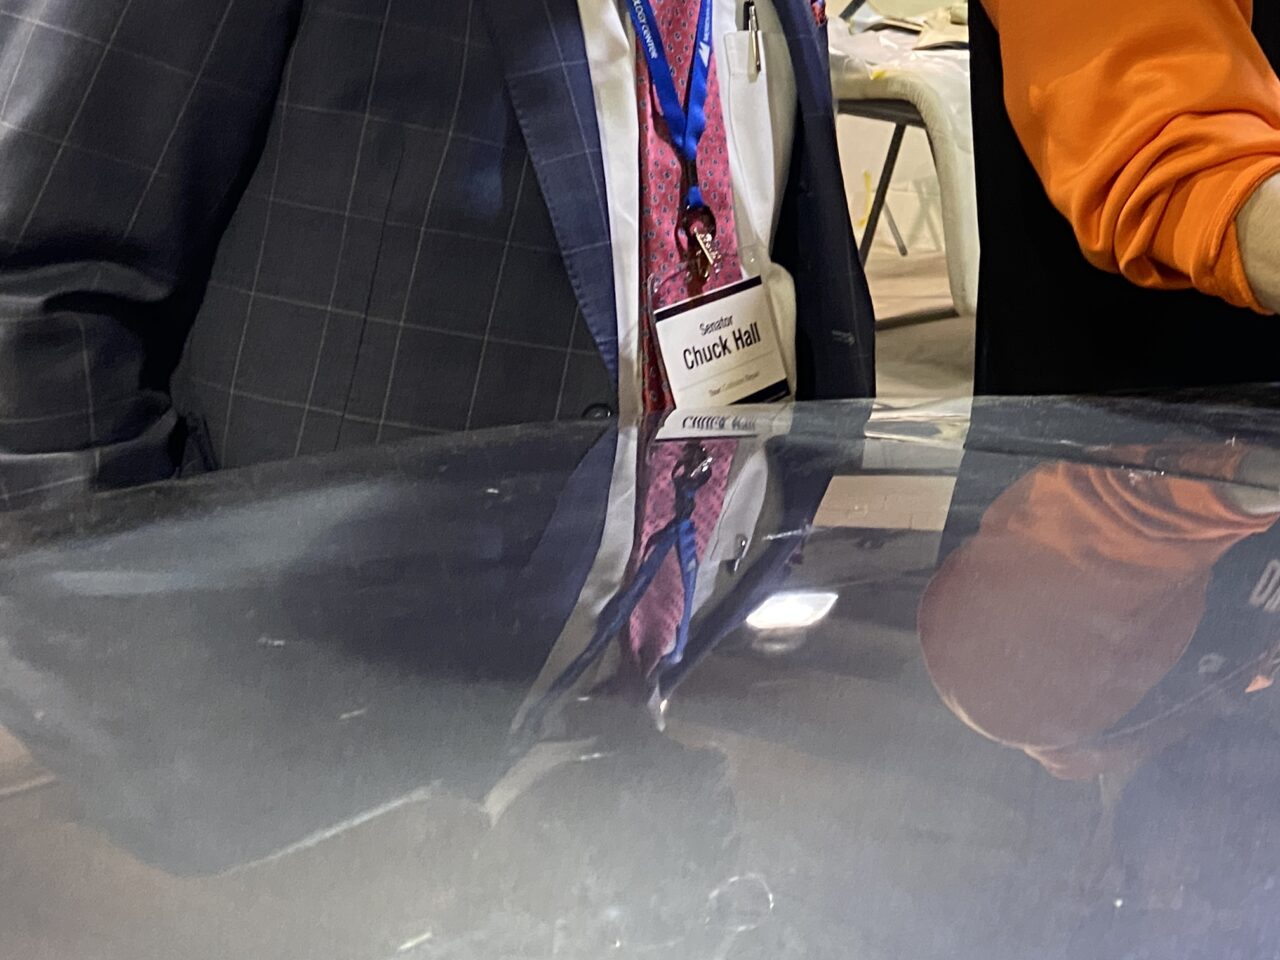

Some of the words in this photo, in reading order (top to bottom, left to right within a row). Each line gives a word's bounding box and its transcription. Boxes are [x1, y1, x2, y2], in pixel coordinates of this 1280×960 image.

[699, 314, 734, 337] Senator
[682, 336, 732, 370] Chuck
[732, 321, 762, 352] Hall
